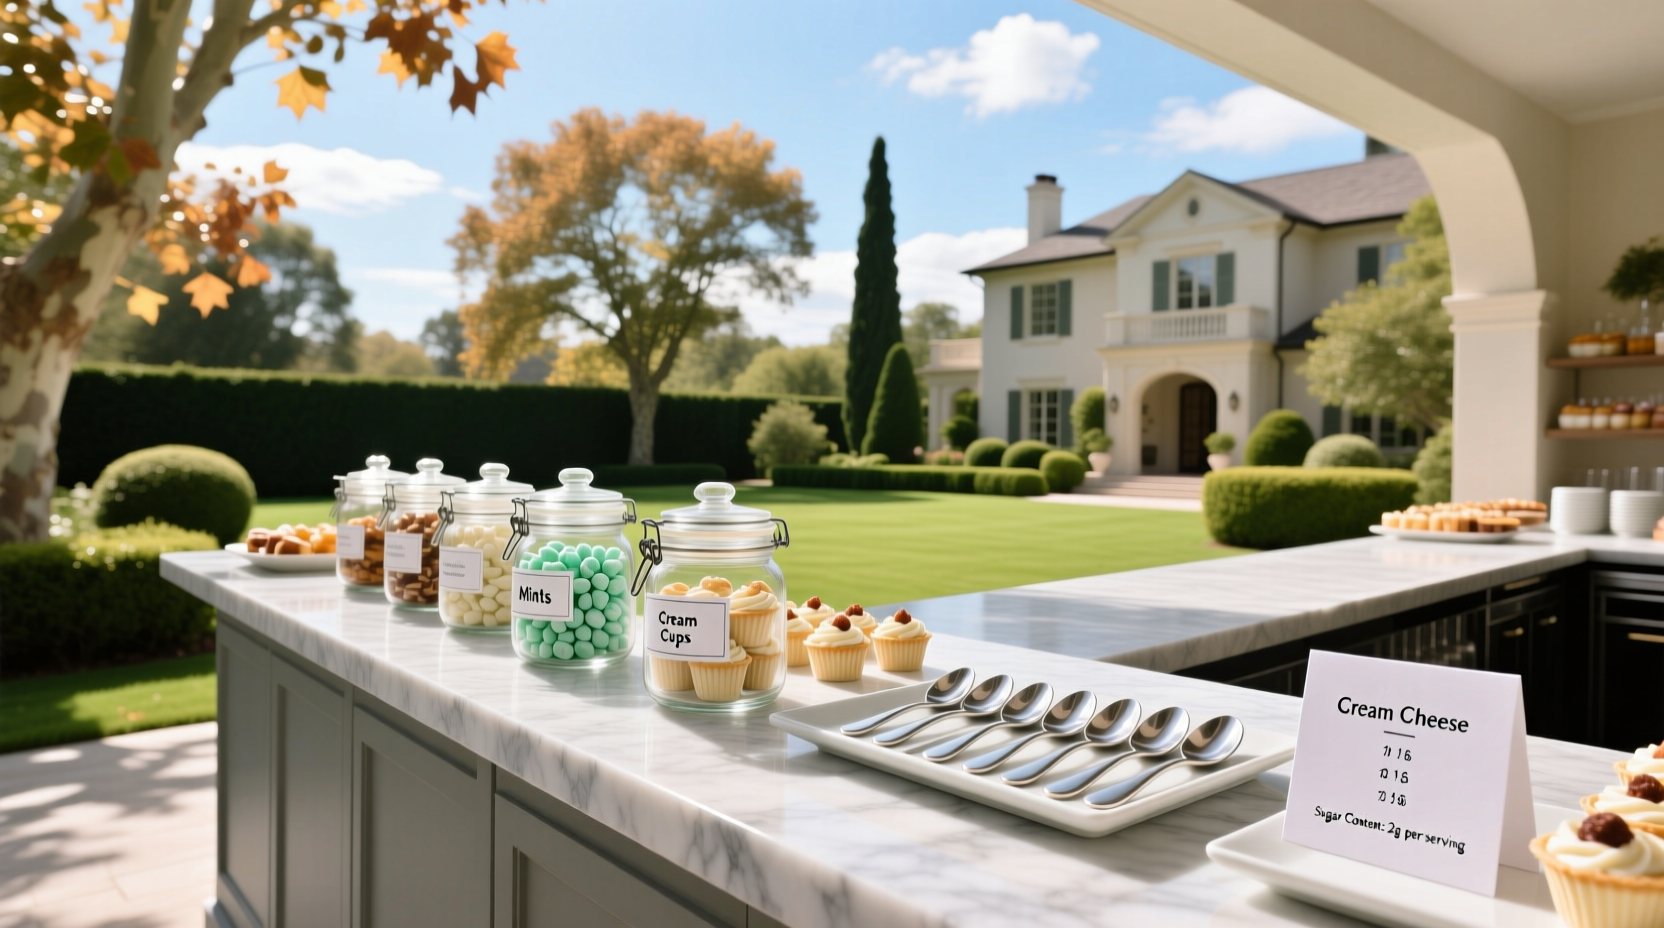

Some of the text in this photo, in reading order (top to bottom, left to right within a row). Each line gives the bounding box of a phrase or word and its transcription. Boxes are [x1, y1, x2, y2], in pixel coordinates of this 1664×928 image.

[518, 585, 552, 605] Mints
[658, 610, 698, 628] Cream
[660, 628, 692, 649] Cups
[1337, 696, 1469, 733] Cream Cheese
[1314, 805, 1342, 824] Sugar
[1387, 822, 1402, 839] 2g
[1404, 828, 1424, 842] per
[1425, 833, 1466, 855] serving
